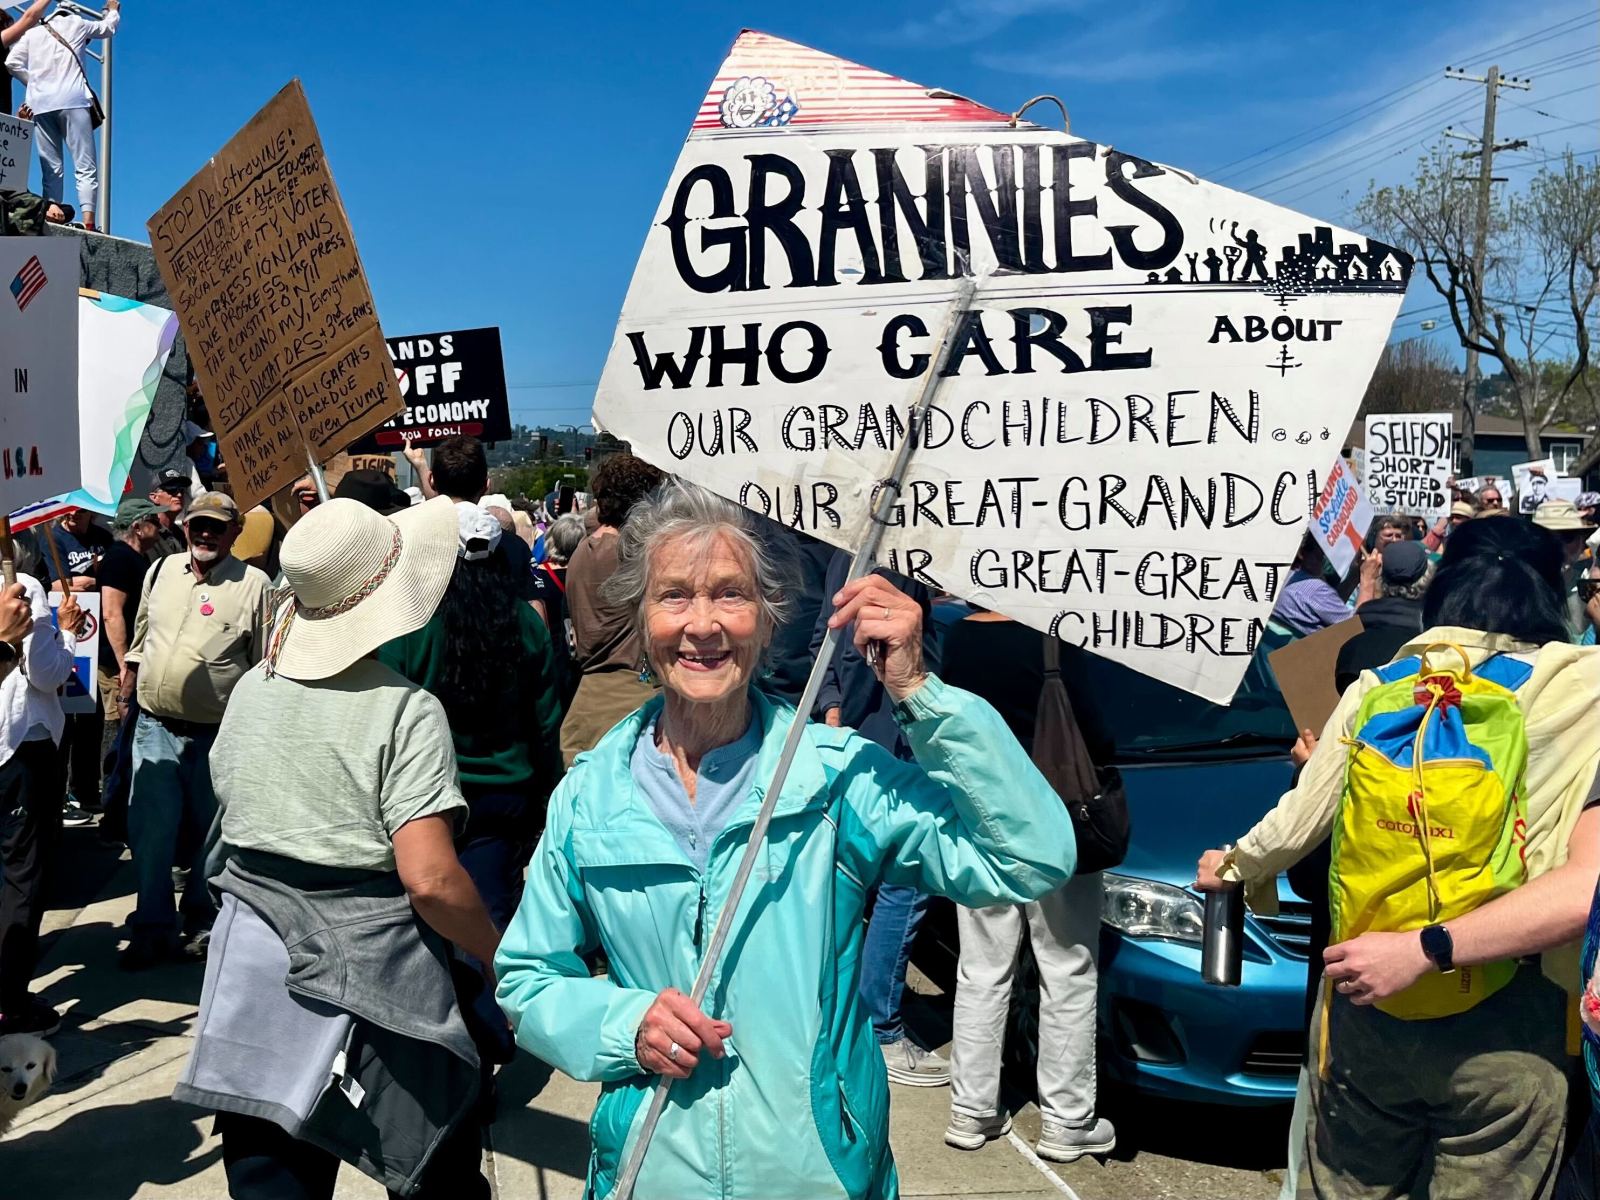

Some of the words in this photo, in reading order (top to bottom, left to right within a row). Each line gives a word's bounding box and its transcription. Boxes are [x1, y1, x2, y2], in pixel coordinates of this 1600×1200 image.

[254, 179, 277, 205] ALL
[282, 182, 333, 224] VOTER
[157, 196, 193, 253] STOP
[661, 141, 1184, 293] GRANNIES
[285, 212, 333, 262] LAWS
[198, 327, 222, 358] DUE
[625, 320, 832, 390] WHO
[876, 304, 1153, 379] CARE
[1208, 314, 1343, 345] ABOUT
[14, 368, 28, 393] IN
[204, 349, 225, 376] THE
[215, 365, 241, 402] OUR
[219, 385, 251, 426] STOP
[403, 399, 490, 425] ECONOMY
[233, 418, 264, 457] MAKE
[267, 401, 289, 427] USA
[258, 441, 275, 464] PAY
[278, 425, 293, 447] ALL
[668, 407, 758, 460] OUR
[1369, 421, 1451, 459] SELFISH
[1369, 456, 1446, 475] SHORT-
[1369, 474, 1441, 491] SIGHTED
[740, 481, 841, 530] OUR
[1369, 489, 1381, 505] &
[1384, 490, 1445, 508] STUPID
[970, 548, 1291, 602] GREAT-GREAT
